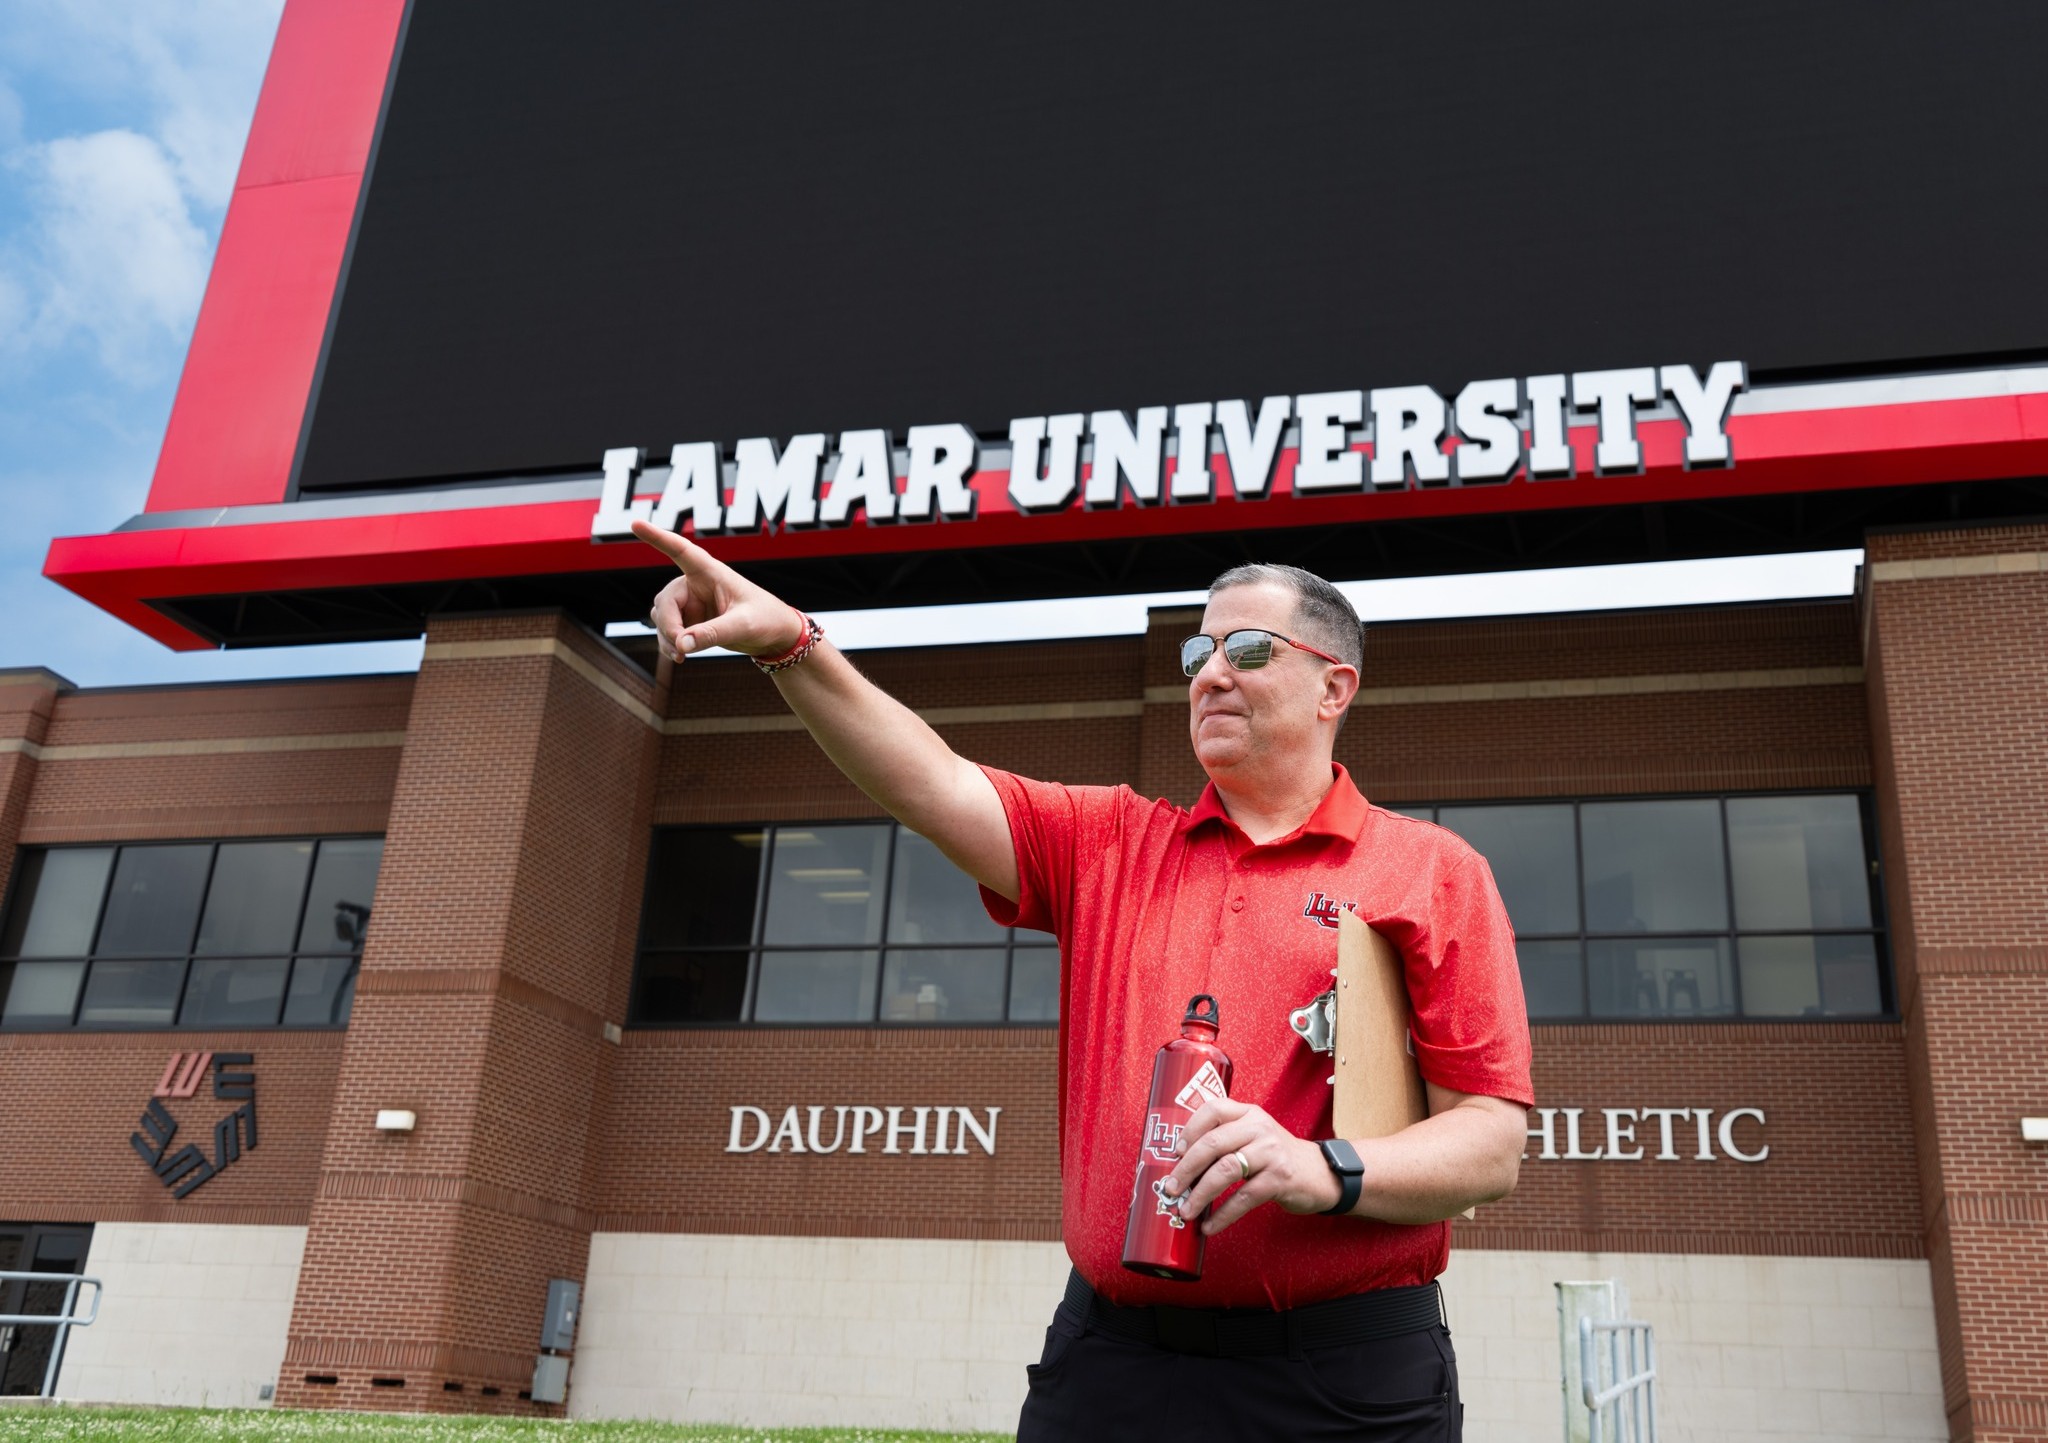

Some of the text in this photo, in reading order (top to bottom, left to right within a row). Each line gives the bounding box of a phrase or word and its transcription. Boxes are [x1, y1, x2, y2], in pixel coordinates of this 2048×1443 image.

[591, 361, 1745, 541] LAMAR UNIVERSITY
[724, 1105, 1002, 1155] DAUPHIN
